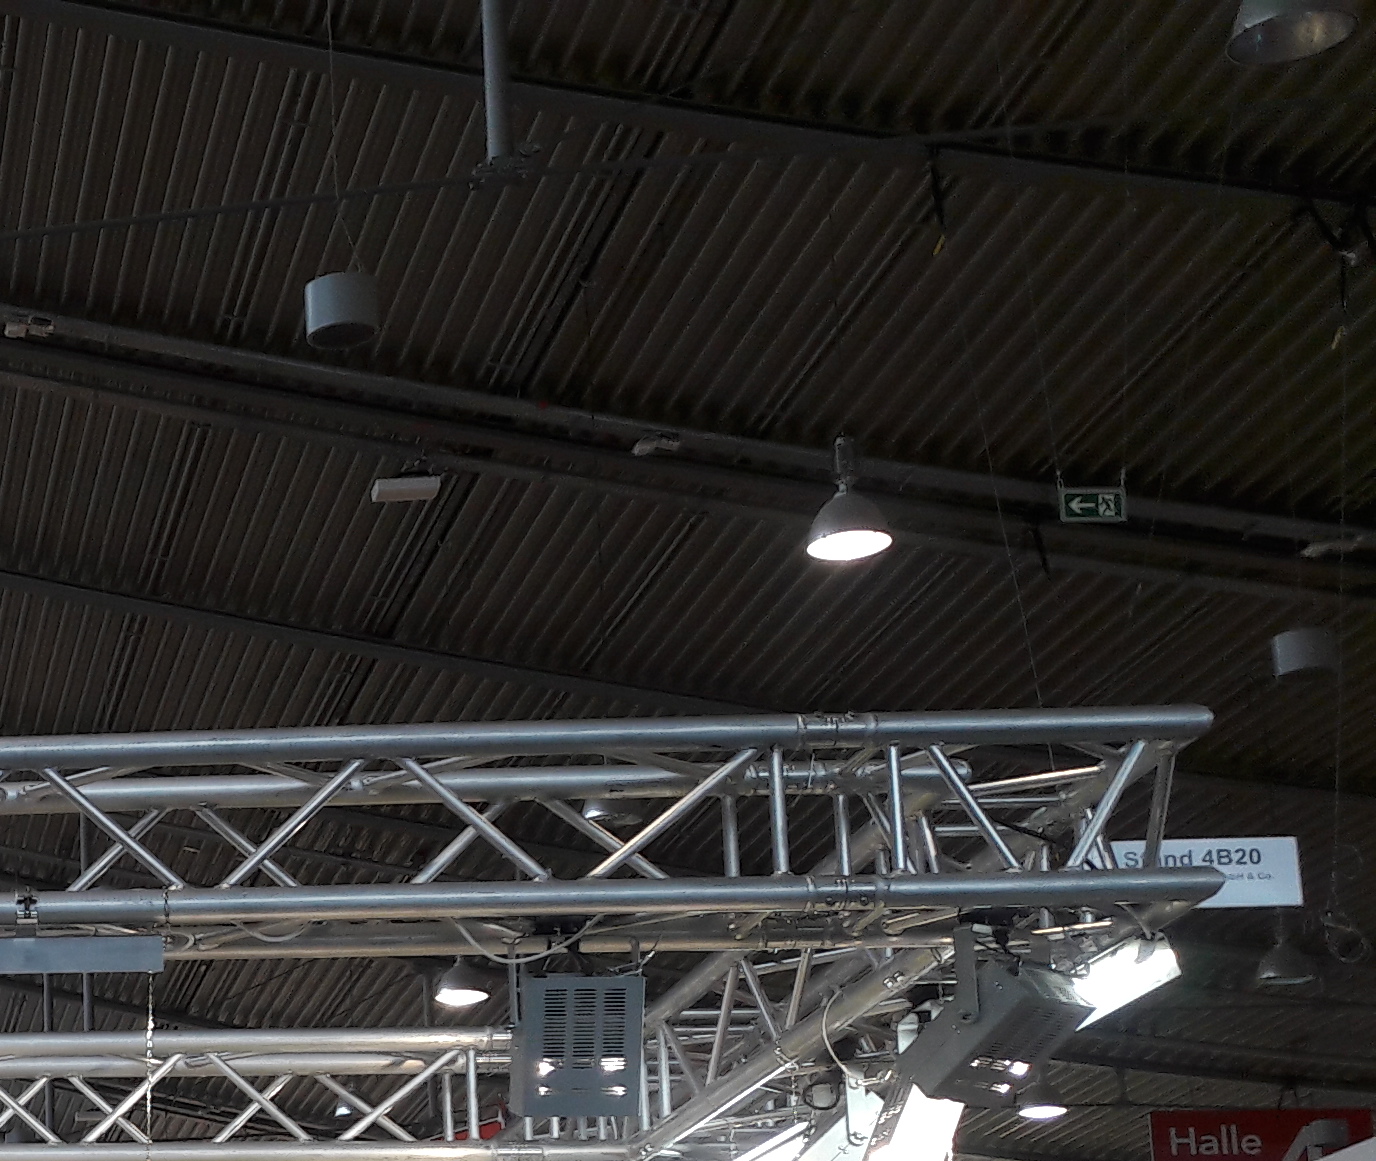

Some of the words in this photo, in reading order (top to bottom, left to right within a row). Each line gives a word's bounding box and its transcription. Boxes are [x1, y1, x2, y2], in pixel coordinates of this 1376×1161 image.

[1123, 849, 1193, 868] Snd
[1201, 848, 1262, 866] 4B20
[1169, 1124, 1263, 1156] Halle
